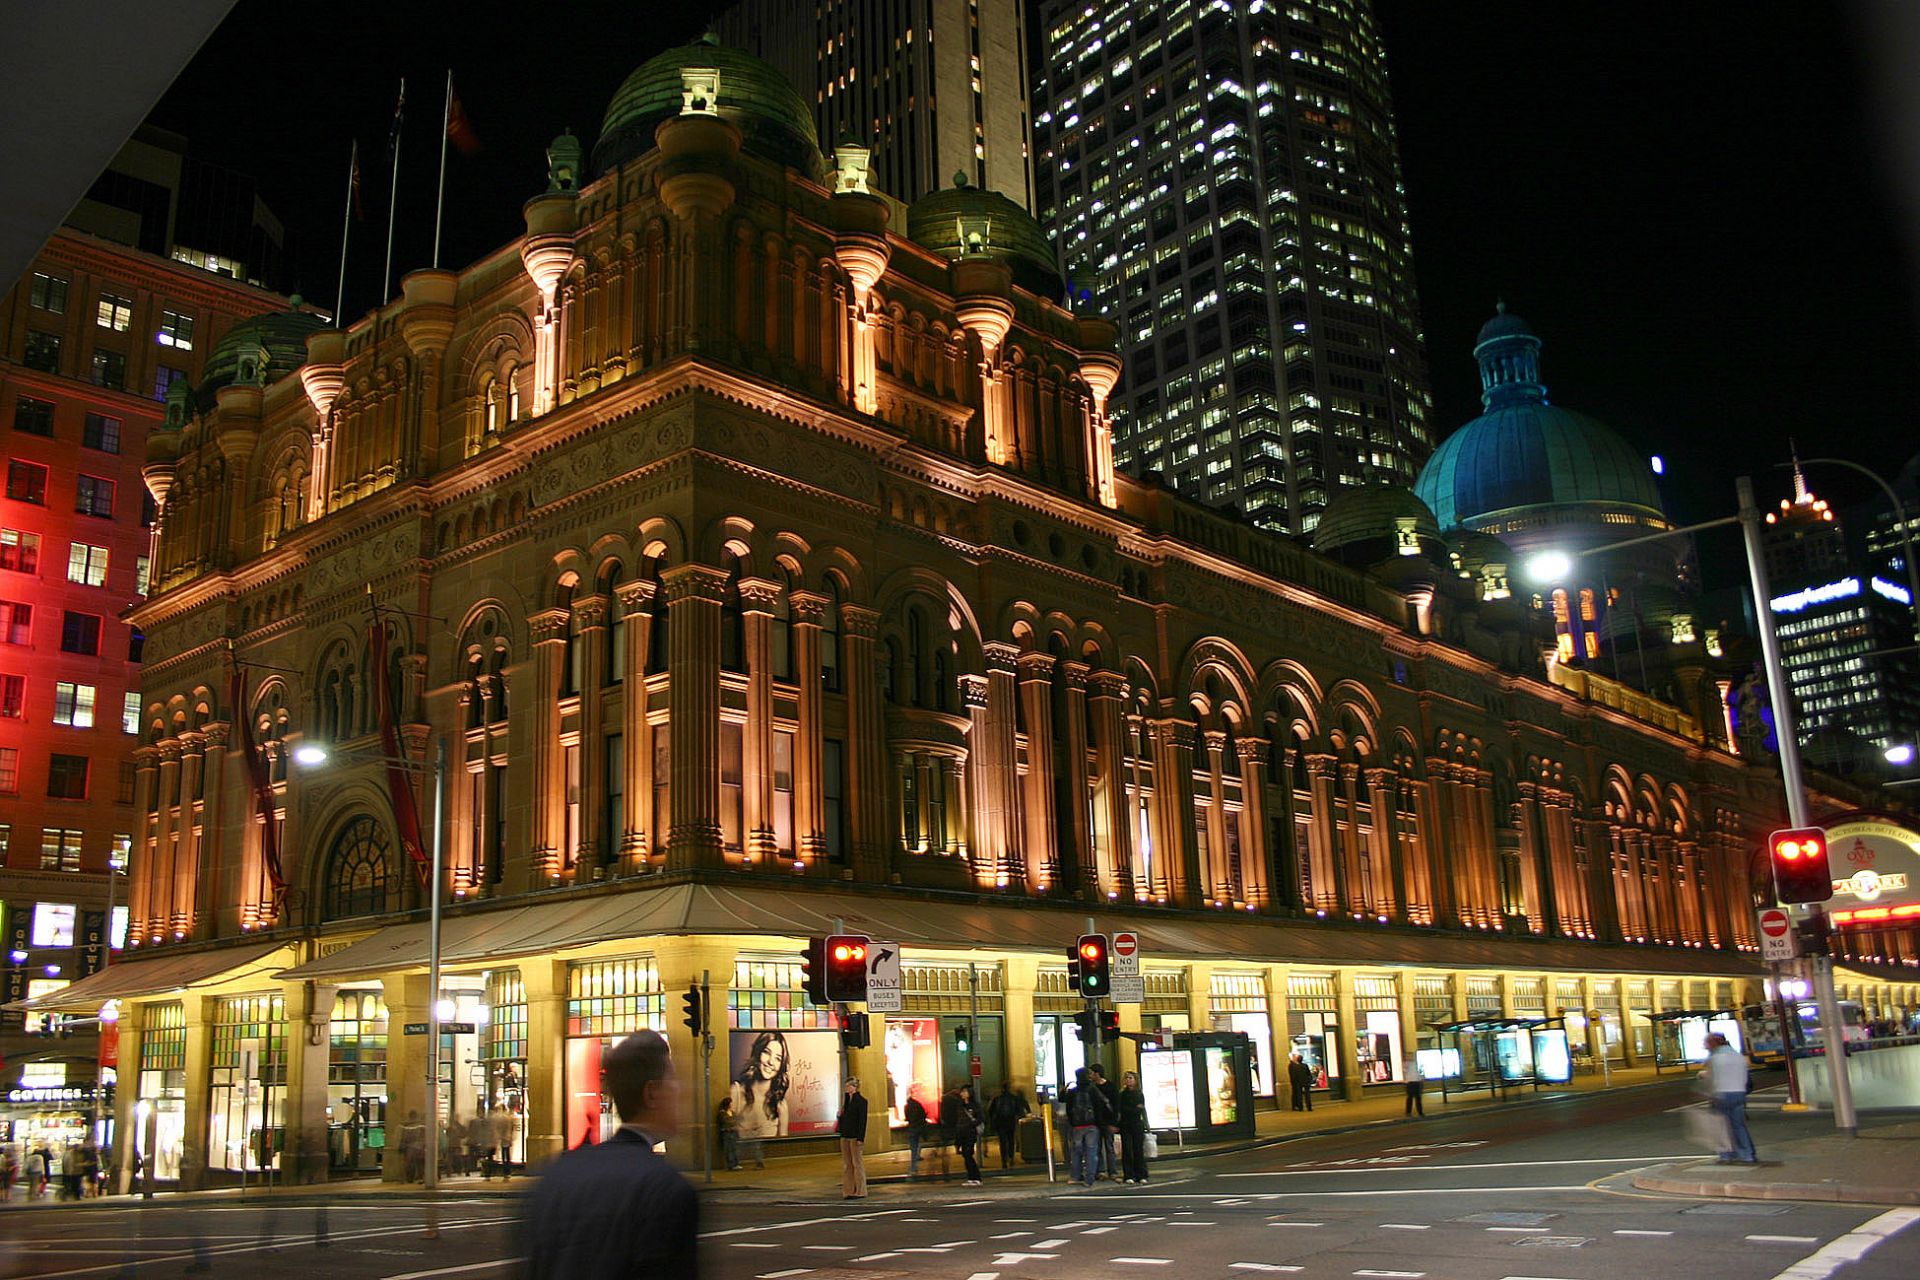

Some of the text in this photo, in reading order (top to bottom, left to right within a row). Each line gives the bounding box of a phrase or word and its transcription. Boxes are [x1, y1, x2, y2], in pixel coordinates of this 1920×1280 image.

[1769, 940, 1785, 948] NO
[1765, 949, 1791, 958] ENTRY
[869, 979, 897, 987] ONLY
[9, 1088, 82, 1101] GOWINGS
